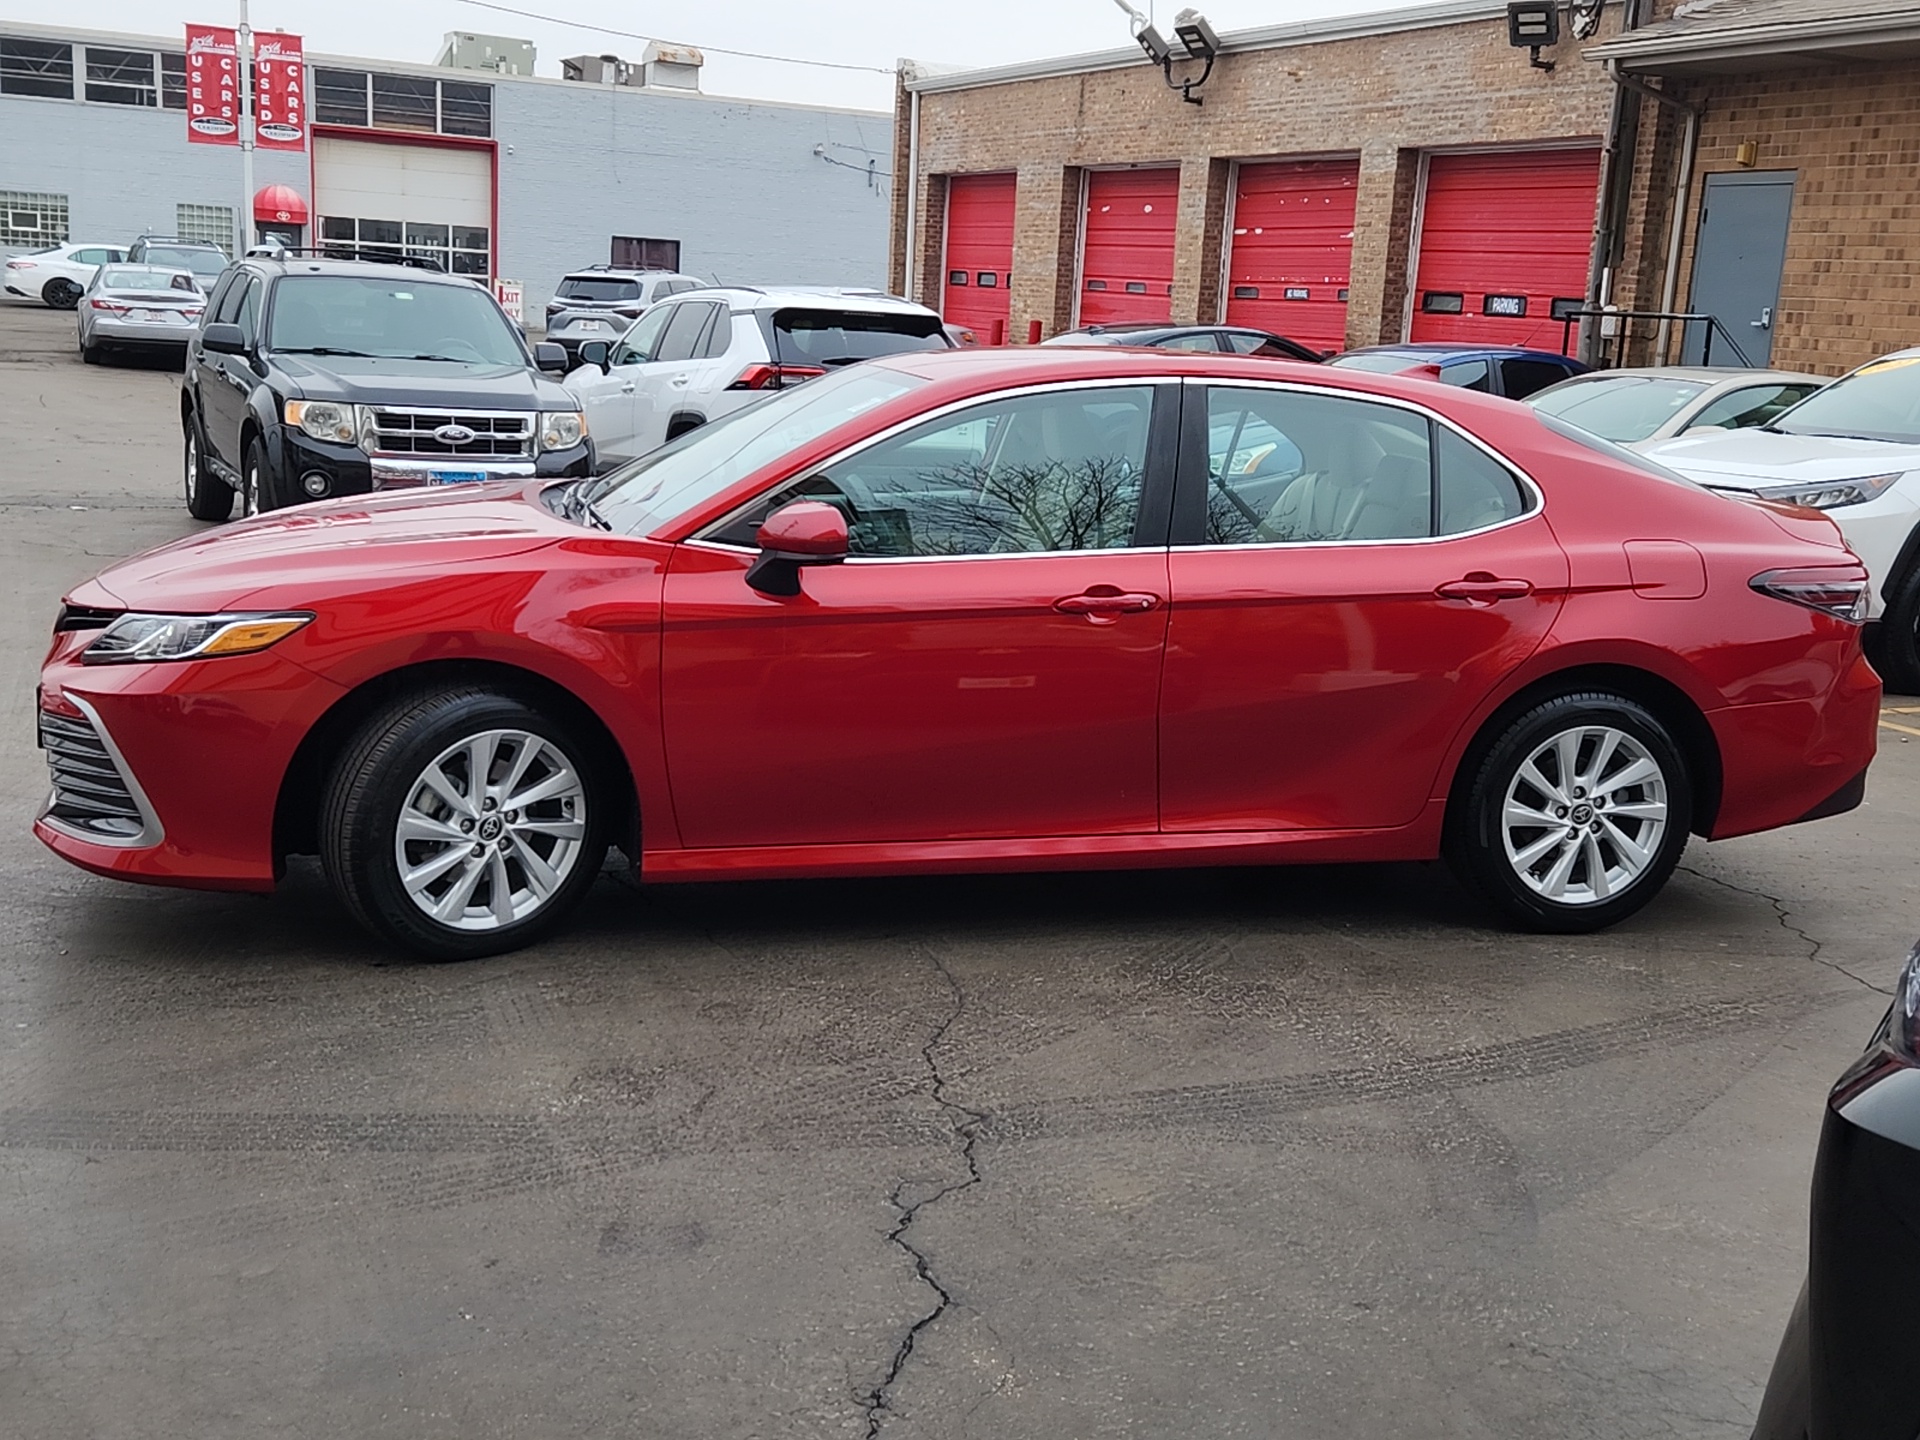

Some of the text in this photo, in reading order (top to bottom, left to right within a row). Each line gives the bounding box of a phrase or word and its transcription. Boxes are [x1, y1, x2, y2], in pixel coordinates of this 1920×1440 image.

[191, 55, 205, 115] USED
[220, 58, 234, 118] CARS
[260, 62, 272, 121] USED
[287, 65, 300, 124] CARS
[500, 292, 520, 304] XIT
[1493, 297, 1519, 313] PARKING
